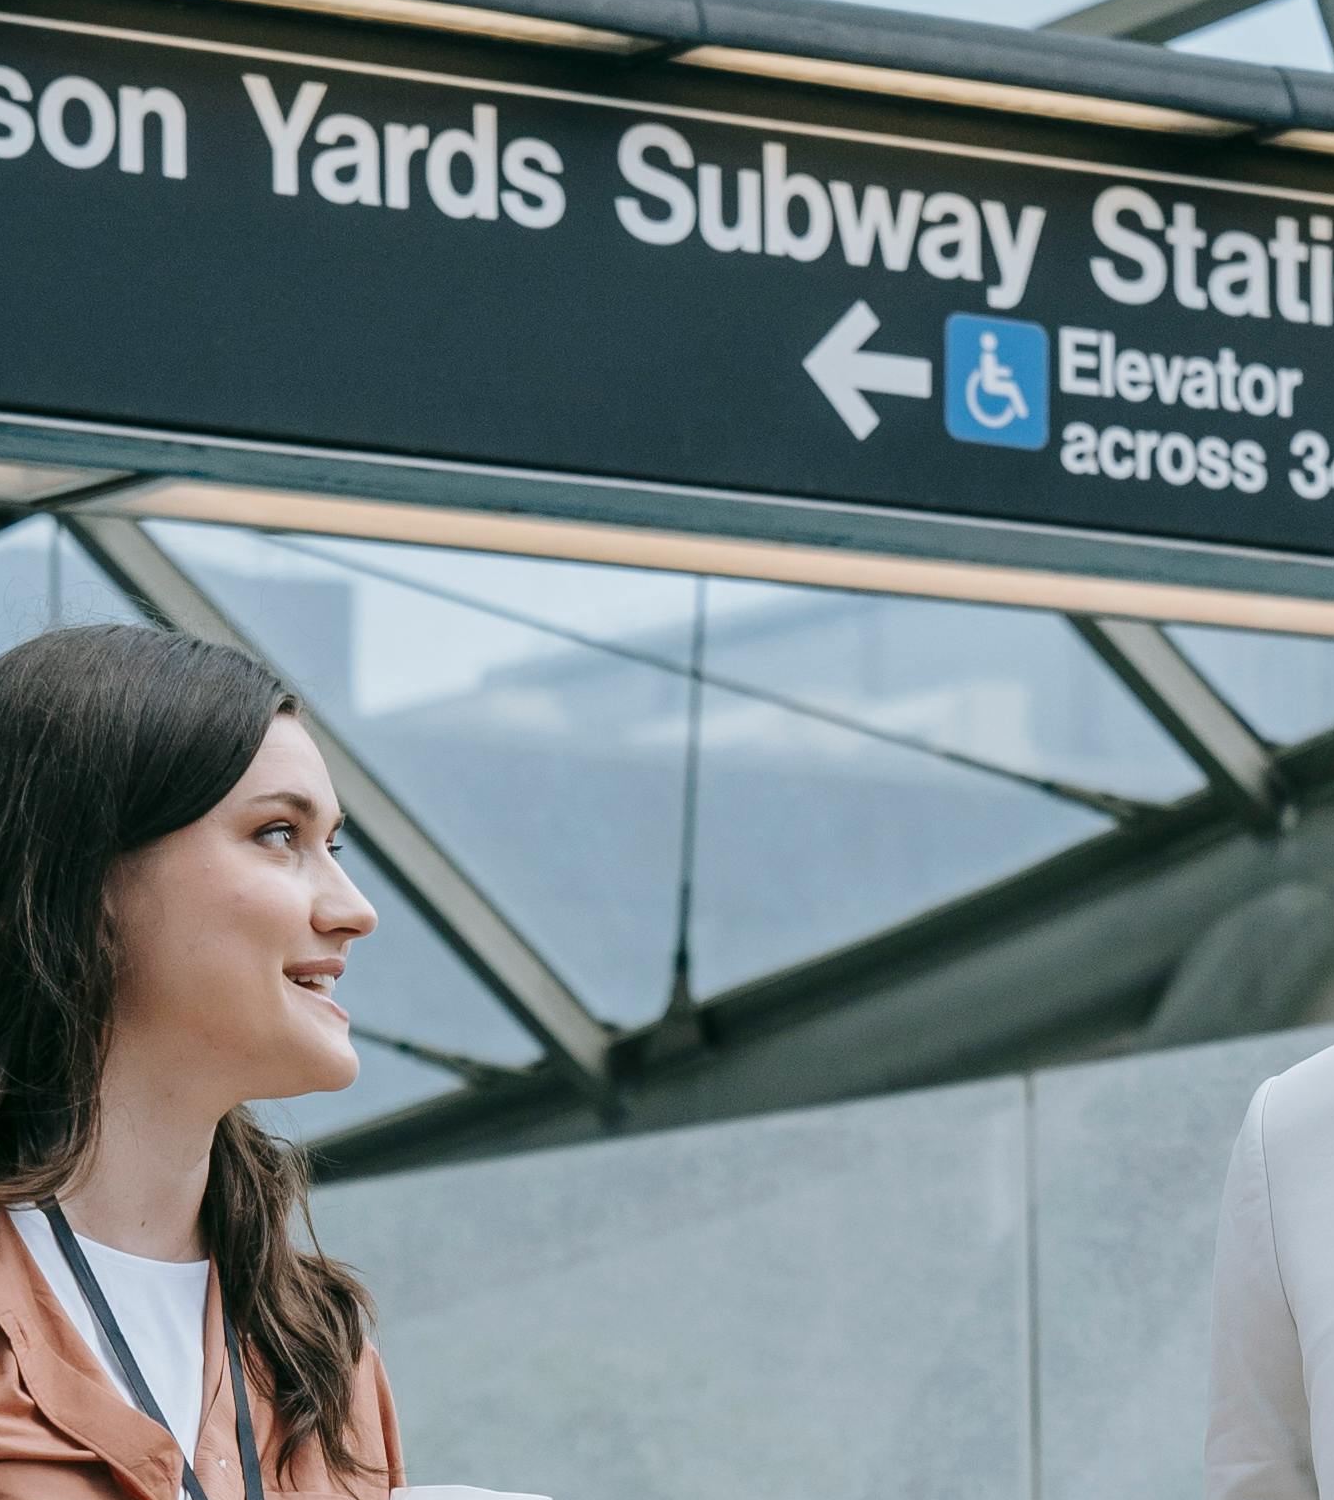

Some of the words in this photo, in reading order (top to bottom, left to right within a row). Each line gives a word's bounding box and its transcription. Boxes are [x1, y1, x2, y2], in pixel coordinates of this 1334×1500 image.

[241, 72, 569, 230] Yards
[614, 122, 1048, 310] Subway
[1057, 325, 1304, 418] Elevator
[1059, 421, 1269, 494] across
